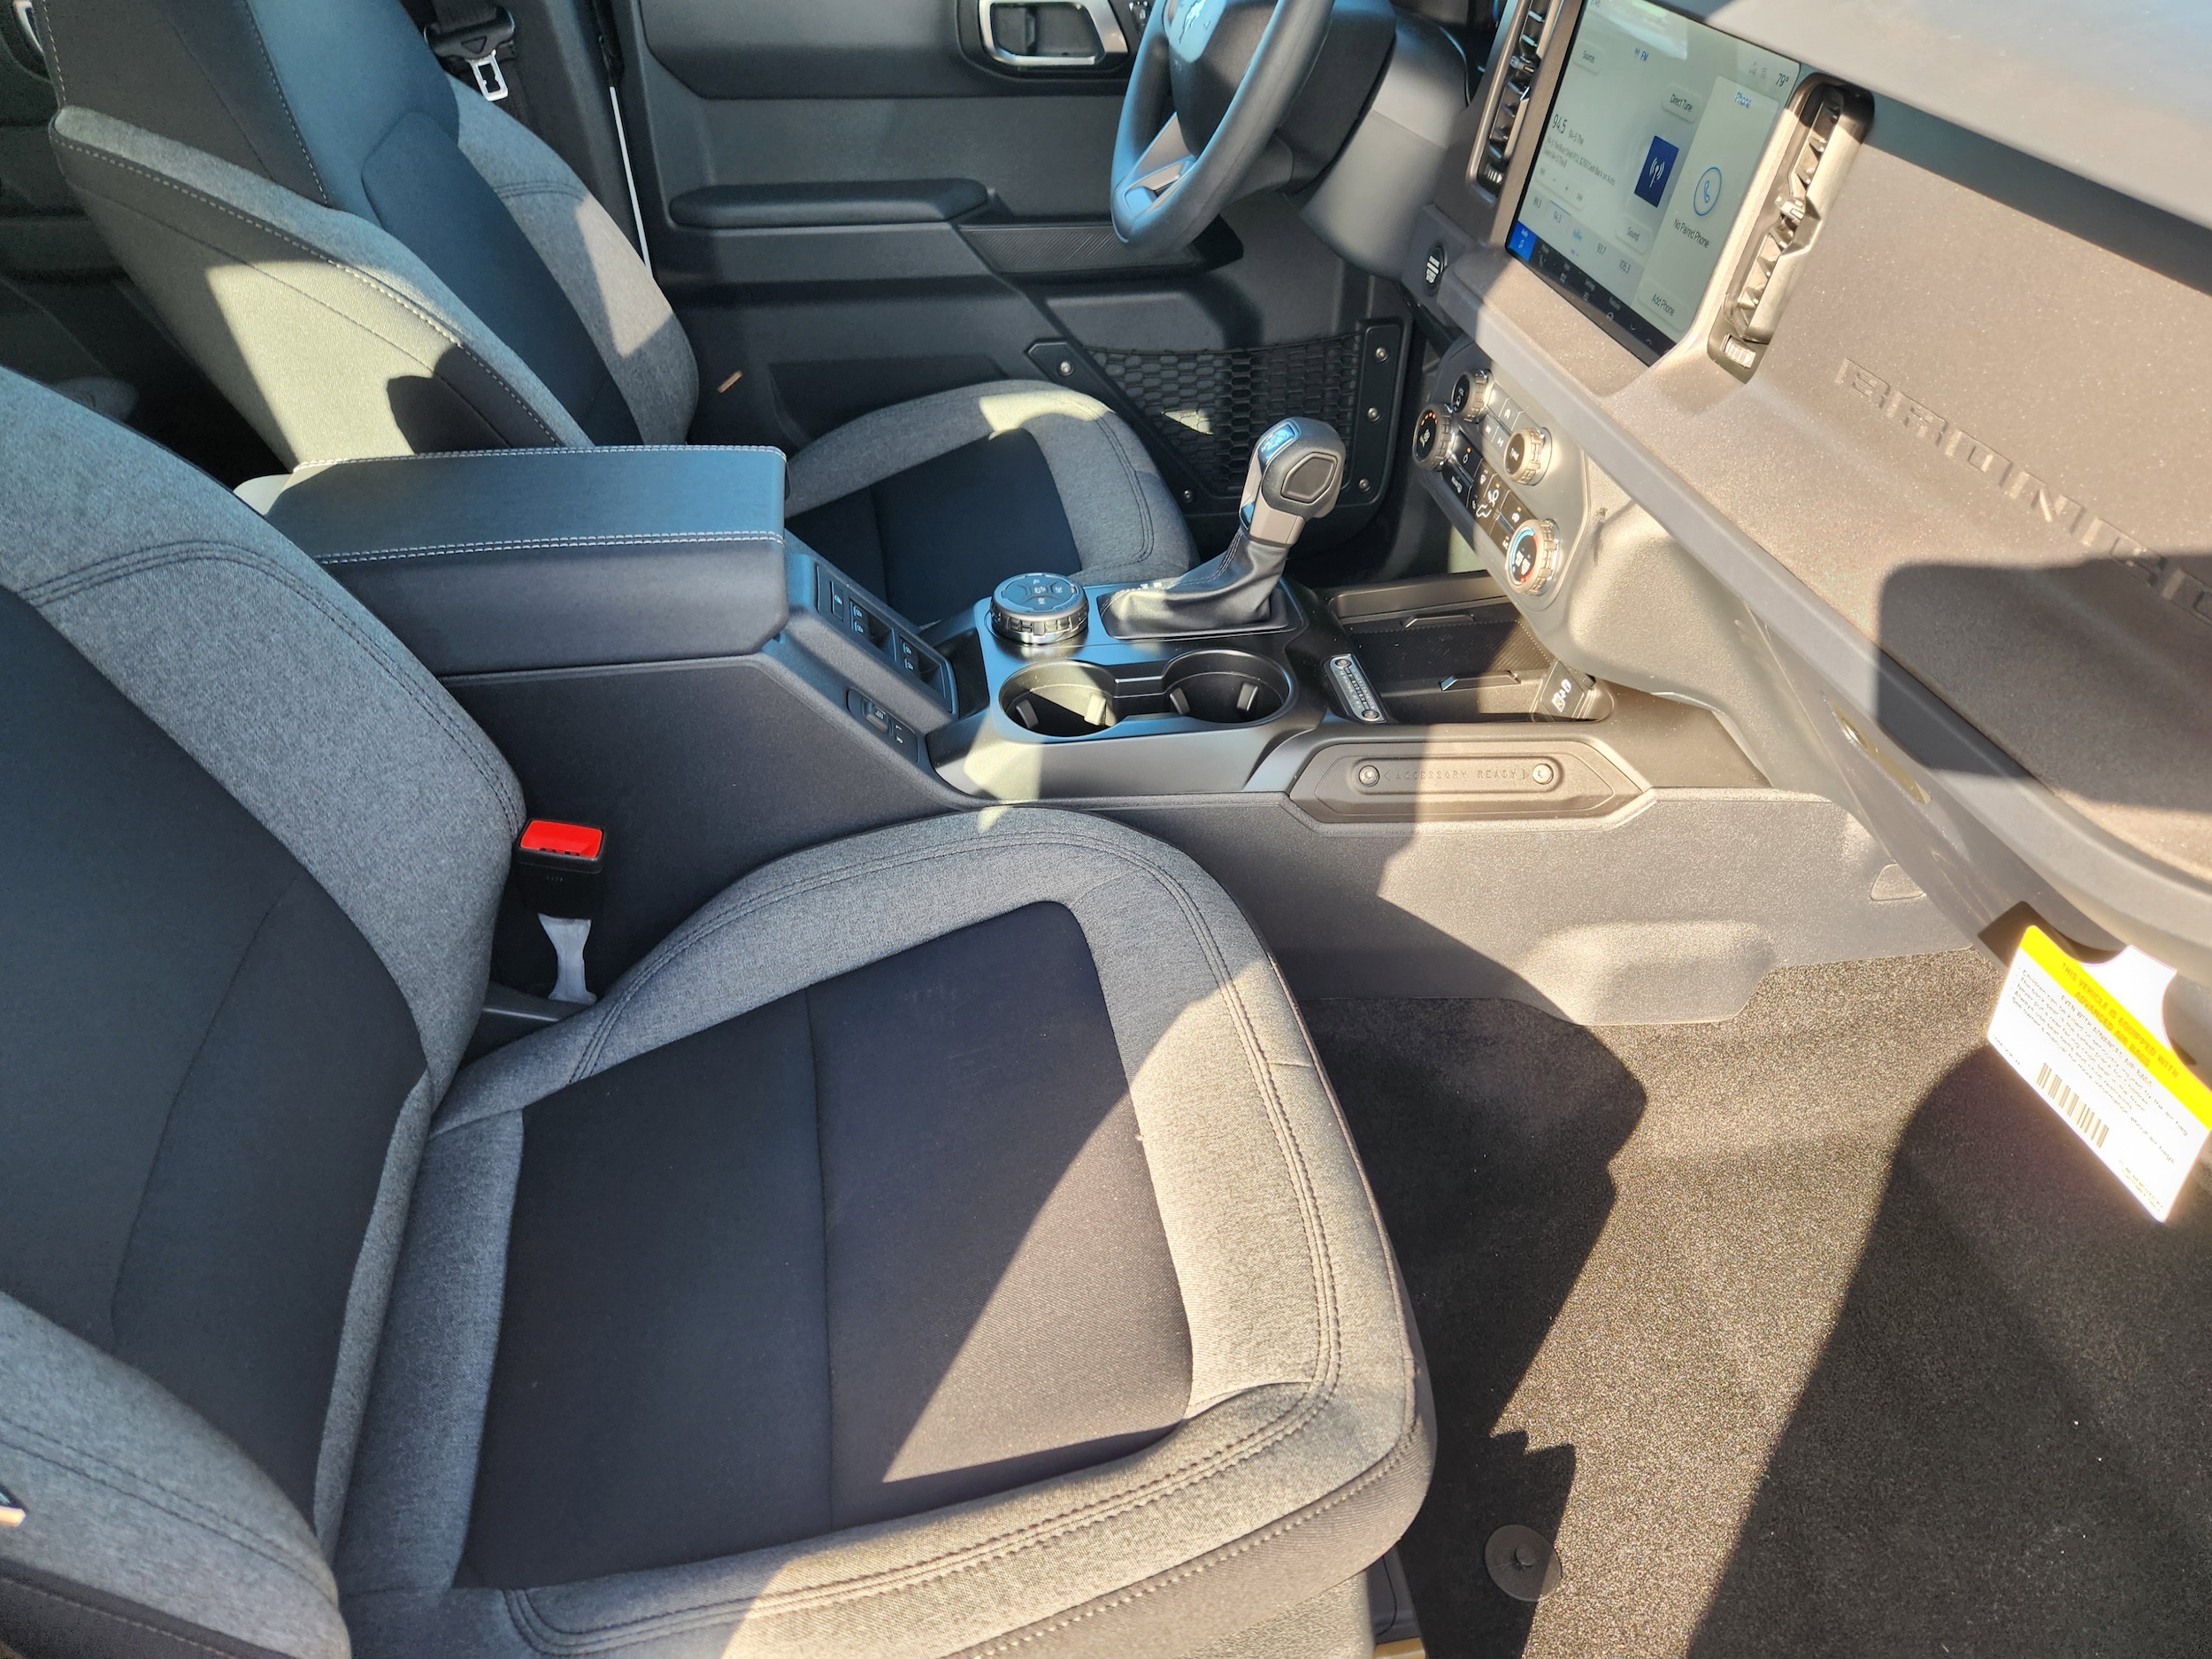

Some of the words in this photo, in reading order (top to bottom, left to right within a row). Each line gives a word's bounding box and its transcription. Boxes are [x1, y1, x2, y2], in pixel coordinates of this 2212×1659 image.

[1640, 50, 1648, 62] FM
[1670, 94, 1682, 107] Direct
[1681, 99, 1693, 112] Tune
[1734, 91, 1752, 109] Phone
[1552, 114, 1568, 134] 94.5
[1627, 227, 1640, 242] Sound
[1673, 219, 1681, 229] No
[1680, 223, 1695, 239] Paired
[1694, 232, 1709, 248] Phone
[1651, 294, 1661, 307] Add
[1660, 299, 1675, 316] Phone
[1834, 357, 2212, 627] BRONCO
[1395, 770, 1468, 780] ACCESSORY
[1477, 769, 1517, 780] READY
[2061, 962, 2078, 981] THIS
[2078, 979, 2108, 1011] VEHICLE
[2108, 1007, 2117, 1020] IS
[2117, 1015, 2157, 1057] EQUIPPED
[2156, 1054, 2179, 1079] WITH
[2073, 989, 2114, 1033] ADVANCED
[2113, 1027, 2128, 1046] AIR
[2128, 1042, 2151, 1068] BAGS
